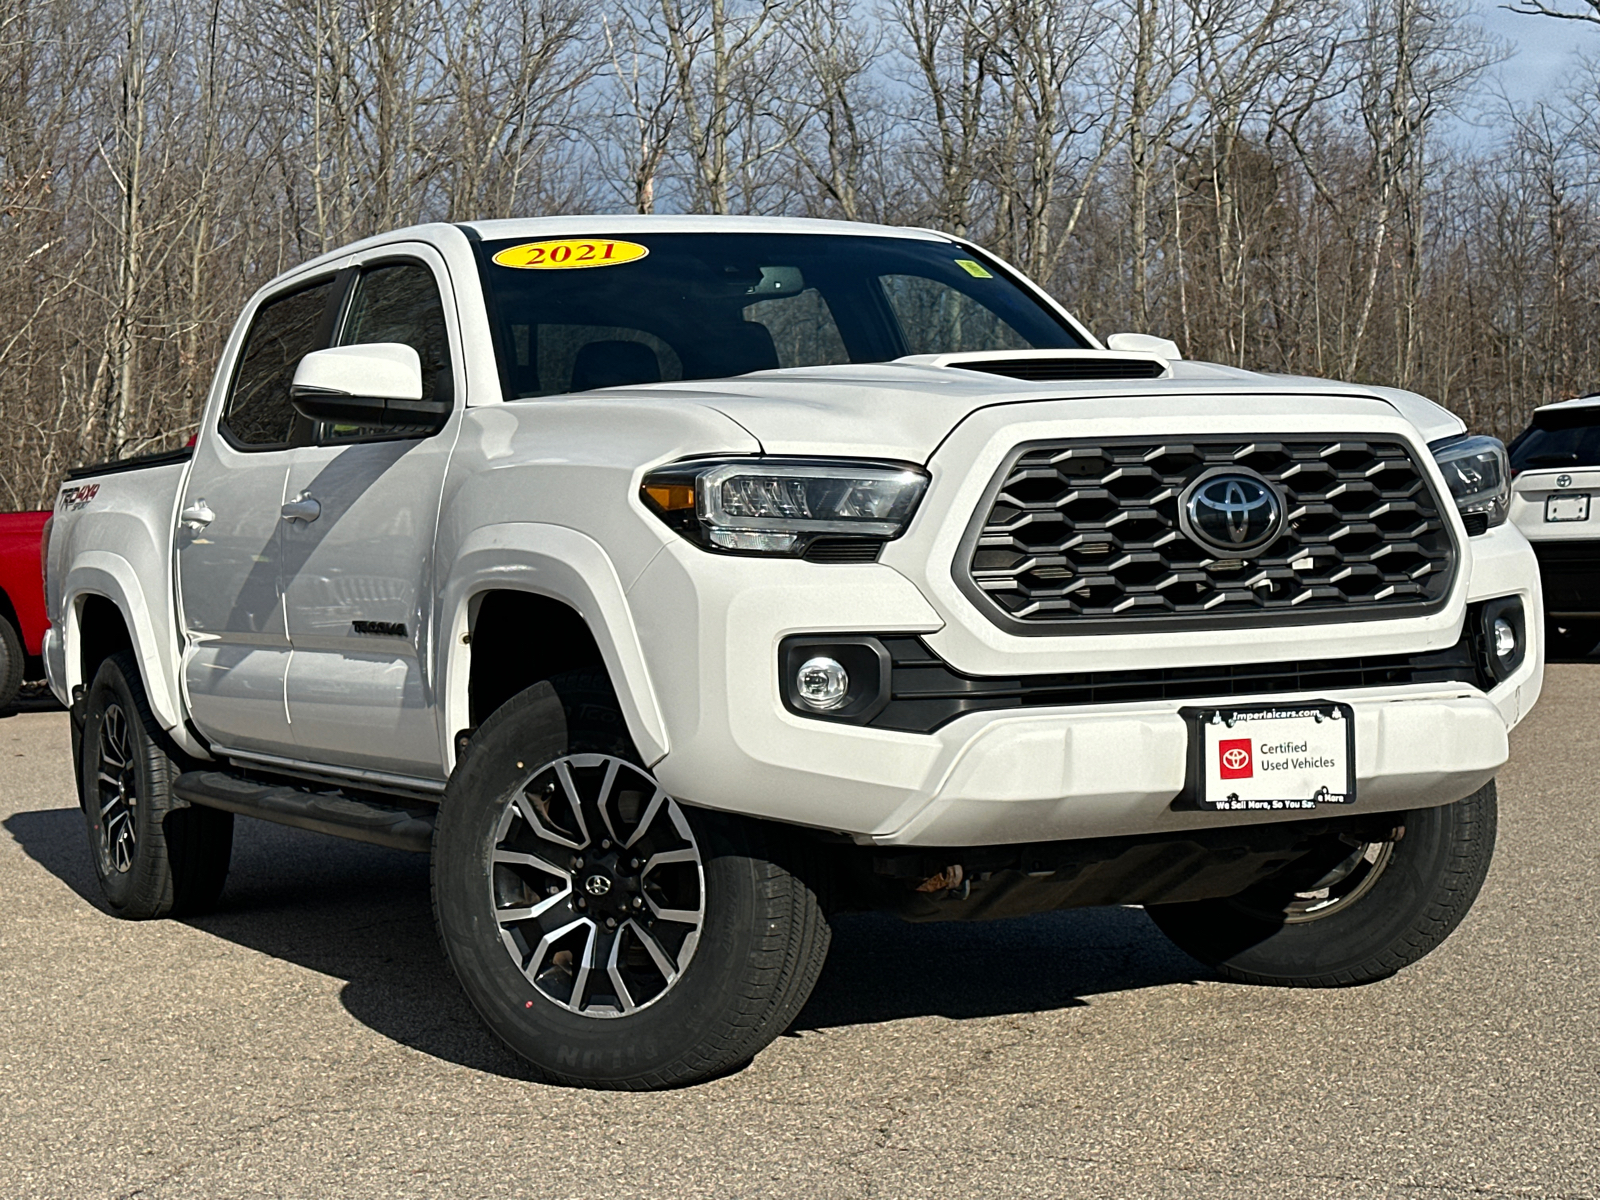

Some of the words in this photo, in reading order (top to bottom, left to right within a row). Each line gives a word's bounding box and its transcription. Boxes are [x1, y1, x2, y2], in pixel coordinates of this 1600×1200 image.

[525, 243, 616, 265] 2021
[1260, 740, 1308, 755] Certified
[1261, 759, 1289, 771] Used
[1291, 757, 1335, 770] Vehicles
[1216, 801, 1230, 810] We
[1231, 800, 1246, 810] Sell
[1248, 800, 1271, 810] More,
[1272, 800, 1283, 809] So
[1284, 800, 1300, 809] You
[1324, 793, 1345, 803] More
